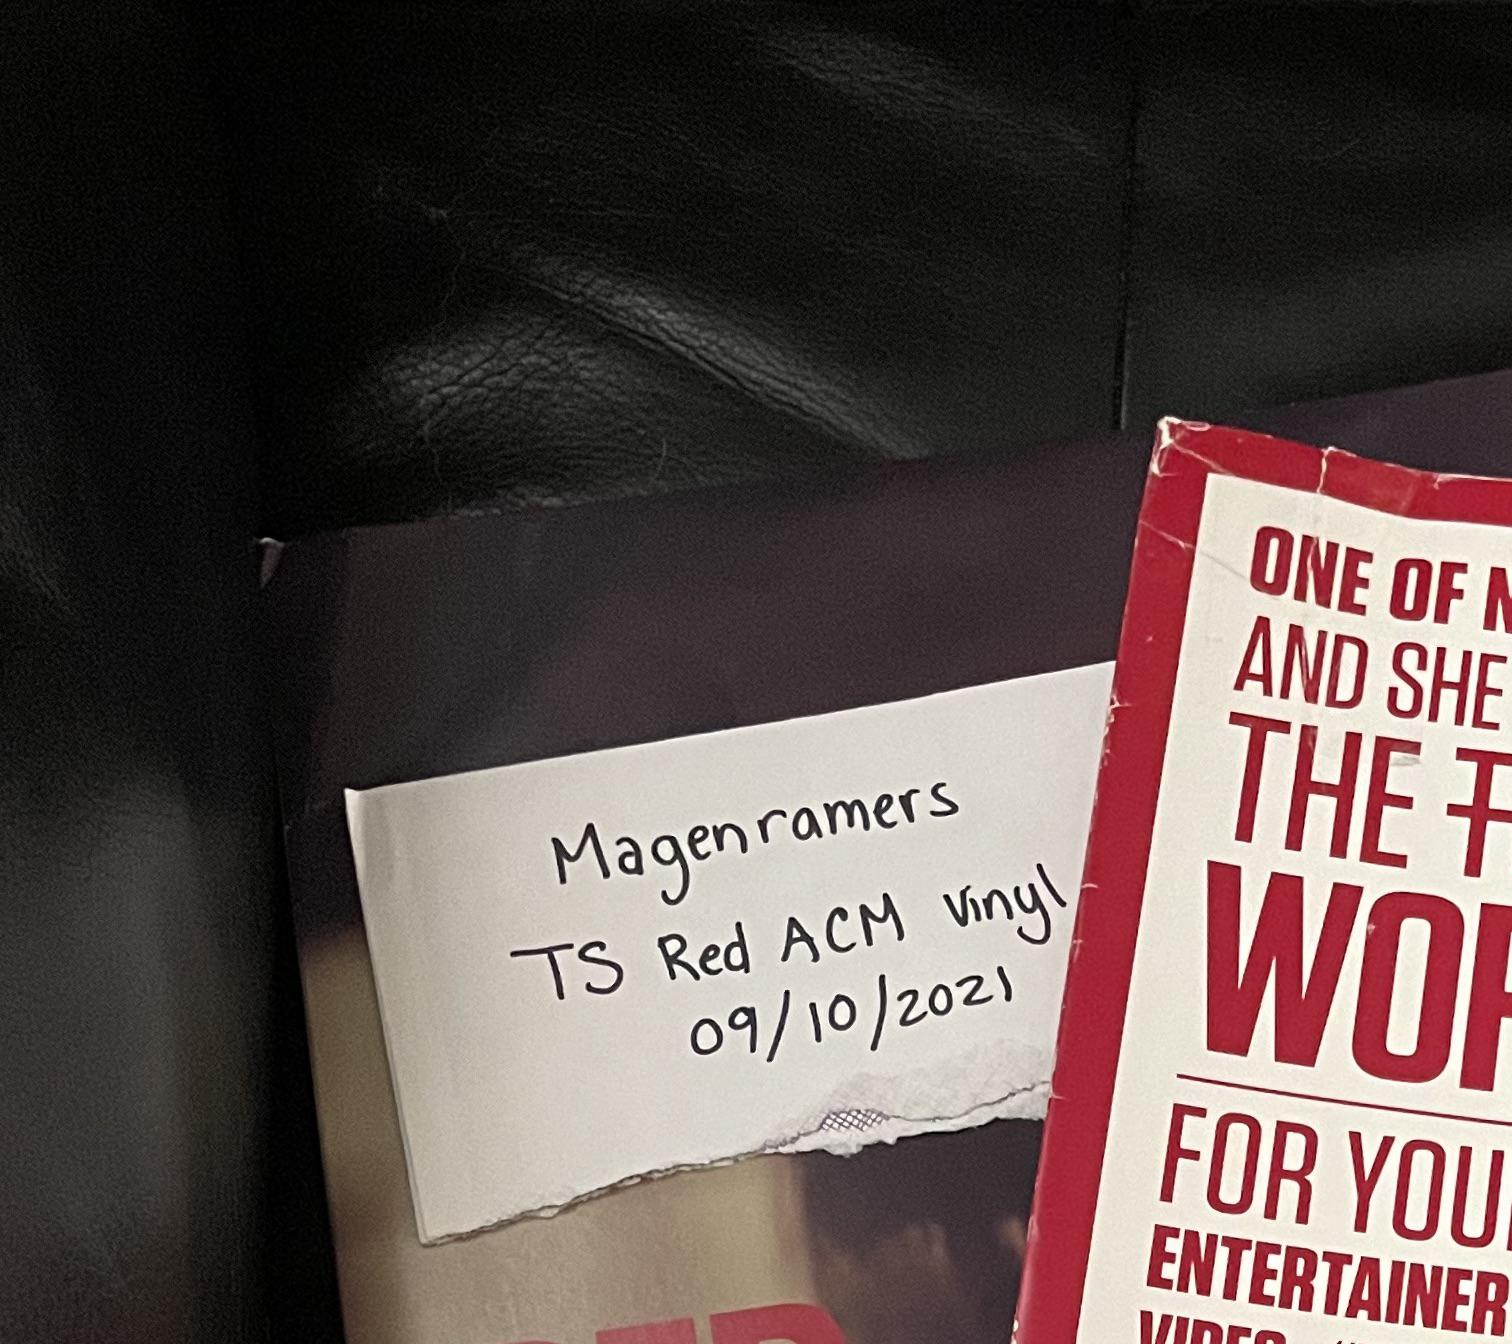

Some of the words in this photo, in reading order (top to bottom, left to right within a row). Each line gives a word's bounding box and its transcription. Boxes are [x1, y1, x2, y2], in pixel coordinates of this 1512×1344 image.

[1250, 526, 1373, 616] ONE
[1390, 558, 1468, 624] OF
[1234, 616, 1368, 709] AND
[1387, 642, 1507, 730] SHE
[552, 783, 958, 909] Magenramers
[1229, 712, 1421, 868] THE
[510, 941, 623, 1000] TS
[658, 922, 750, 980] Red
[781, 893, 904, 962] ACM
[691, 966, 1012, 1062] 09/10/2021
[1160, 1103, 1318, 1225] FOR
[1147, 1224, 1509, 1336] ENTERTAINER
